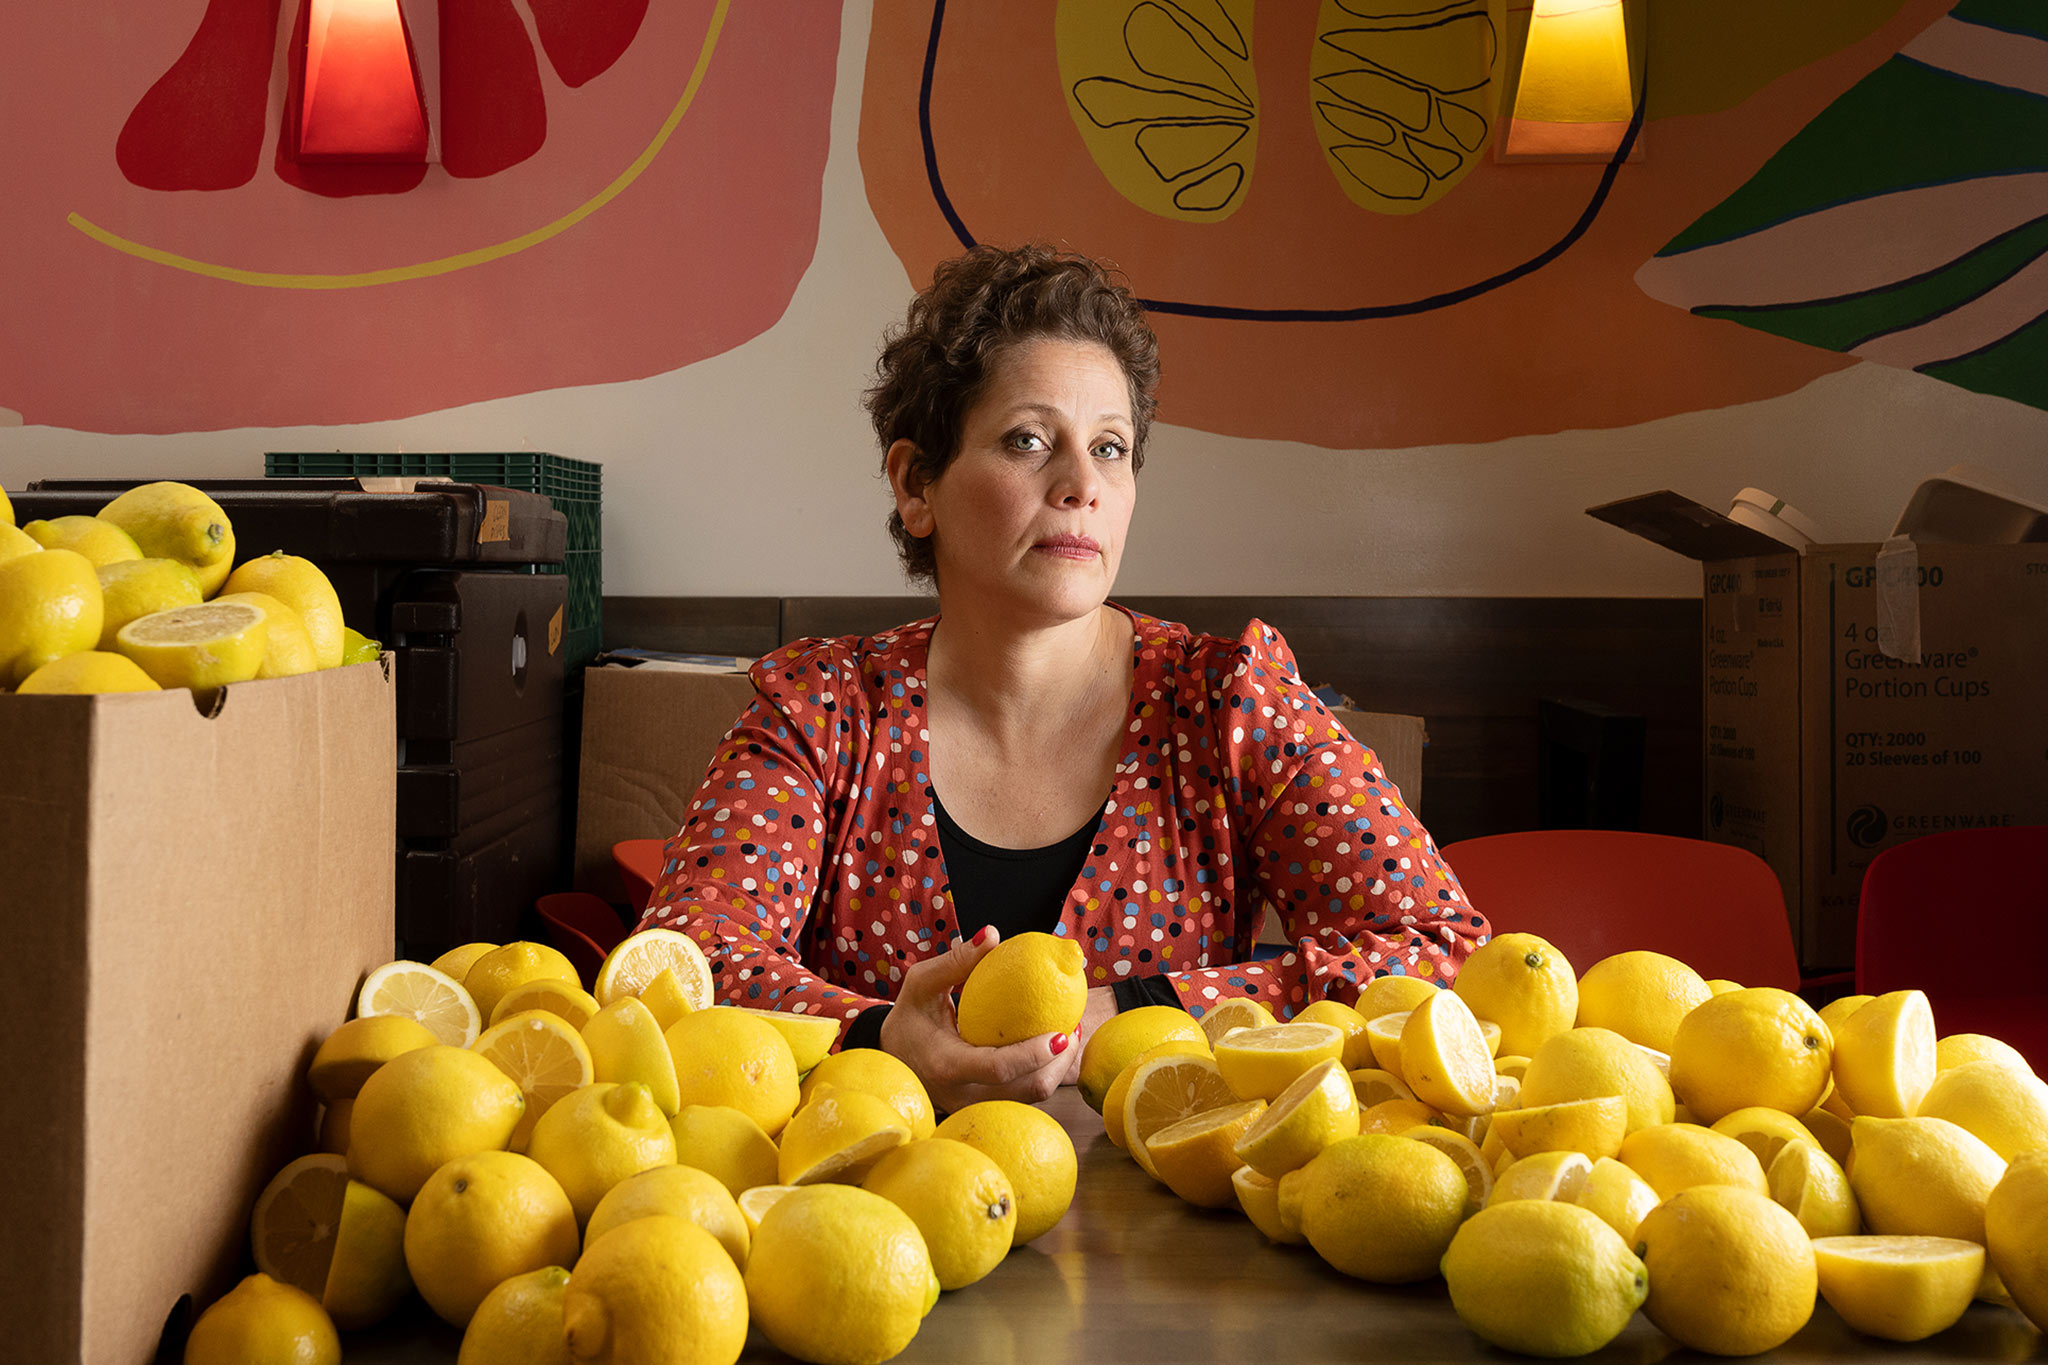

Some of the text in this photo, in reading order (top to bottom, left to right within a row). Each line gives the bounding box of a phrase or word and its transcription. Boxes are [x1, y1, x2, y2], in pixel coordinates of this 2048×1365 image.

[1844, 622, 1858, 643] 4
[1709, 675, 1759, 702] Portion Cups
[1846, 676, 1990, 702] Portion Cups
[1845, 732, 1926, 747] QTY: 2000
[1845, 750, 1981, 766] 20 Sleeves of 100
